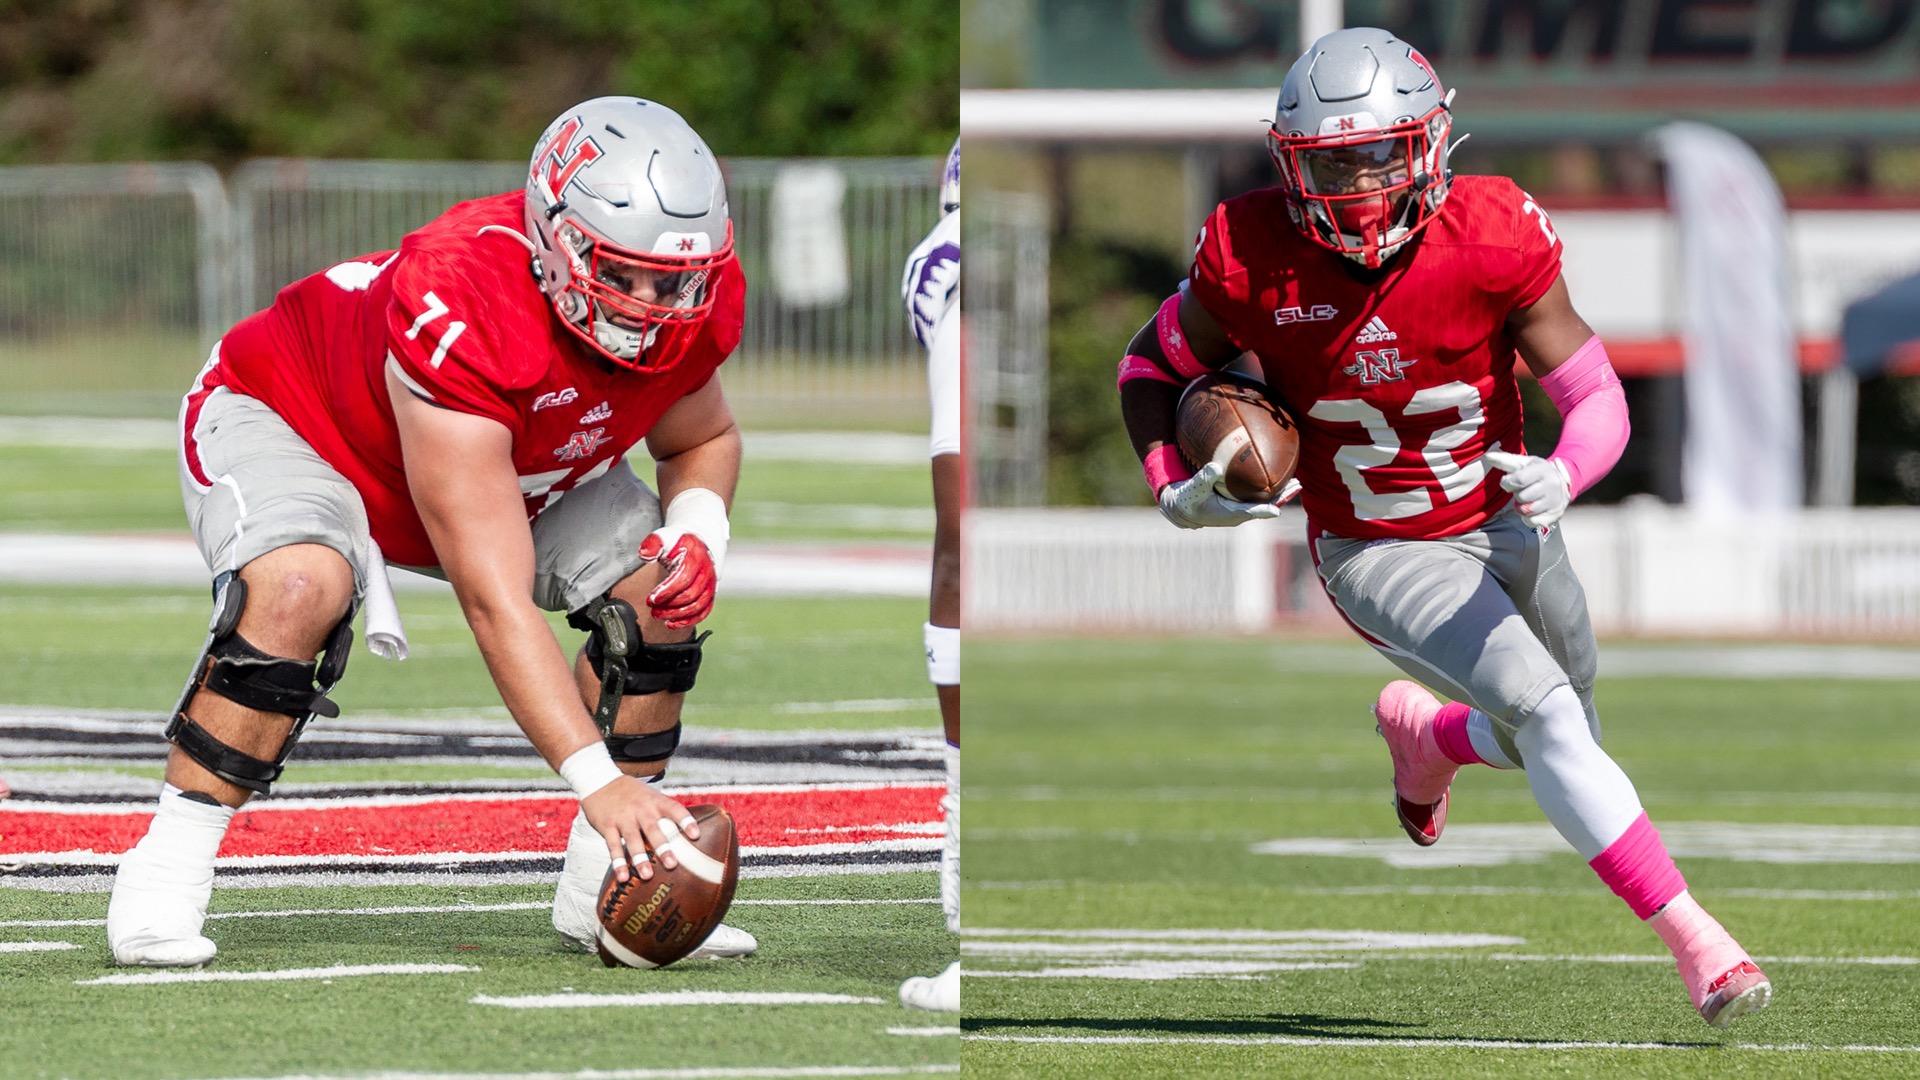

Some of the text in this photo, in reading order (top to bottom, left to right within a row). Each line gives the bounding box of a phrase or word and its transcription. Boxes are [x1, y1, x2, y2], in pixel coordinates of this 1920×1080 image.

[530, 115, 605, 204] N
[404, 290, 467, 370] 71
[1275, 305, 1334, 326] SLC
[1356, 331, 1398, 345] adidas
[1356, 347, 1405, 386] N
[579, 409, 613, 425] adidas
[558, 427, 605, 461] N
[1307, 380, 1490, 521] 22
[624, 882, 672, 935] Wilson
